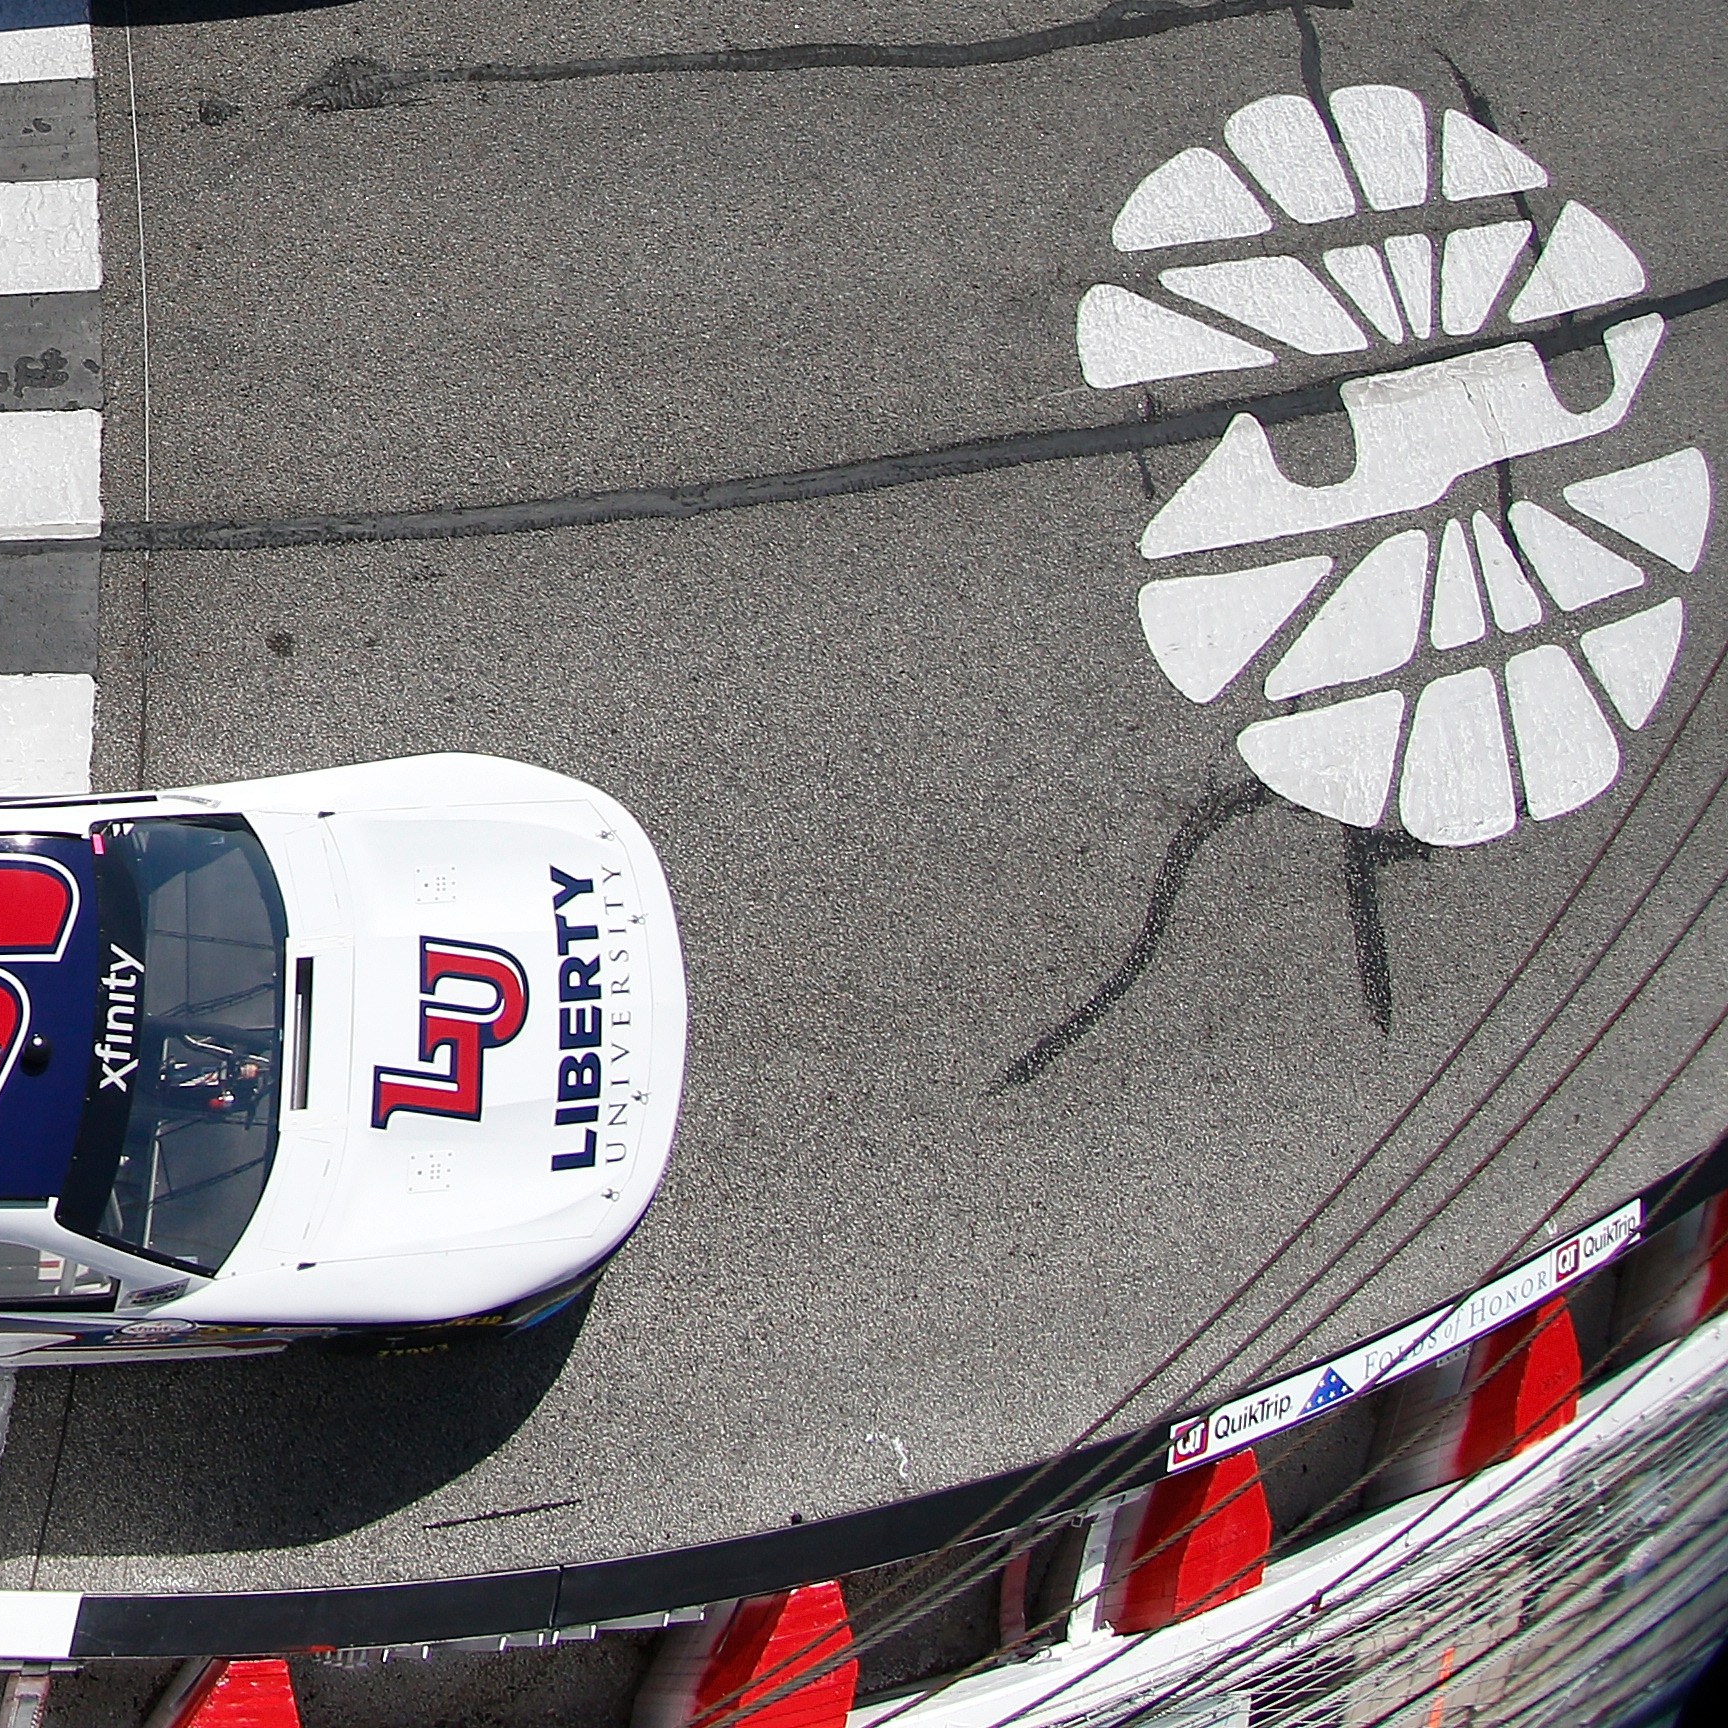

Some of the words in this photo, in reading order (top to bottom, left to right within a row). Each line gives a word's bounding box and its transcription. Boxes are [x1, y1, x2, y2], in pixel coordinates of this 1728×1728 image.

[97, 943, 146, 1095] xfinity
[550, 863, 601, 1174] LIBERTY
[603, 863, 626, 1165] UNIVERSITY
[1557, 1244, 1578, 1276] QT
[1583, 1215, 1636, 1258] QuikTrip
[1468, 1269, 1548, 1329] HONOR
[1214, 1392, 1292, 1440] QuikTrip
